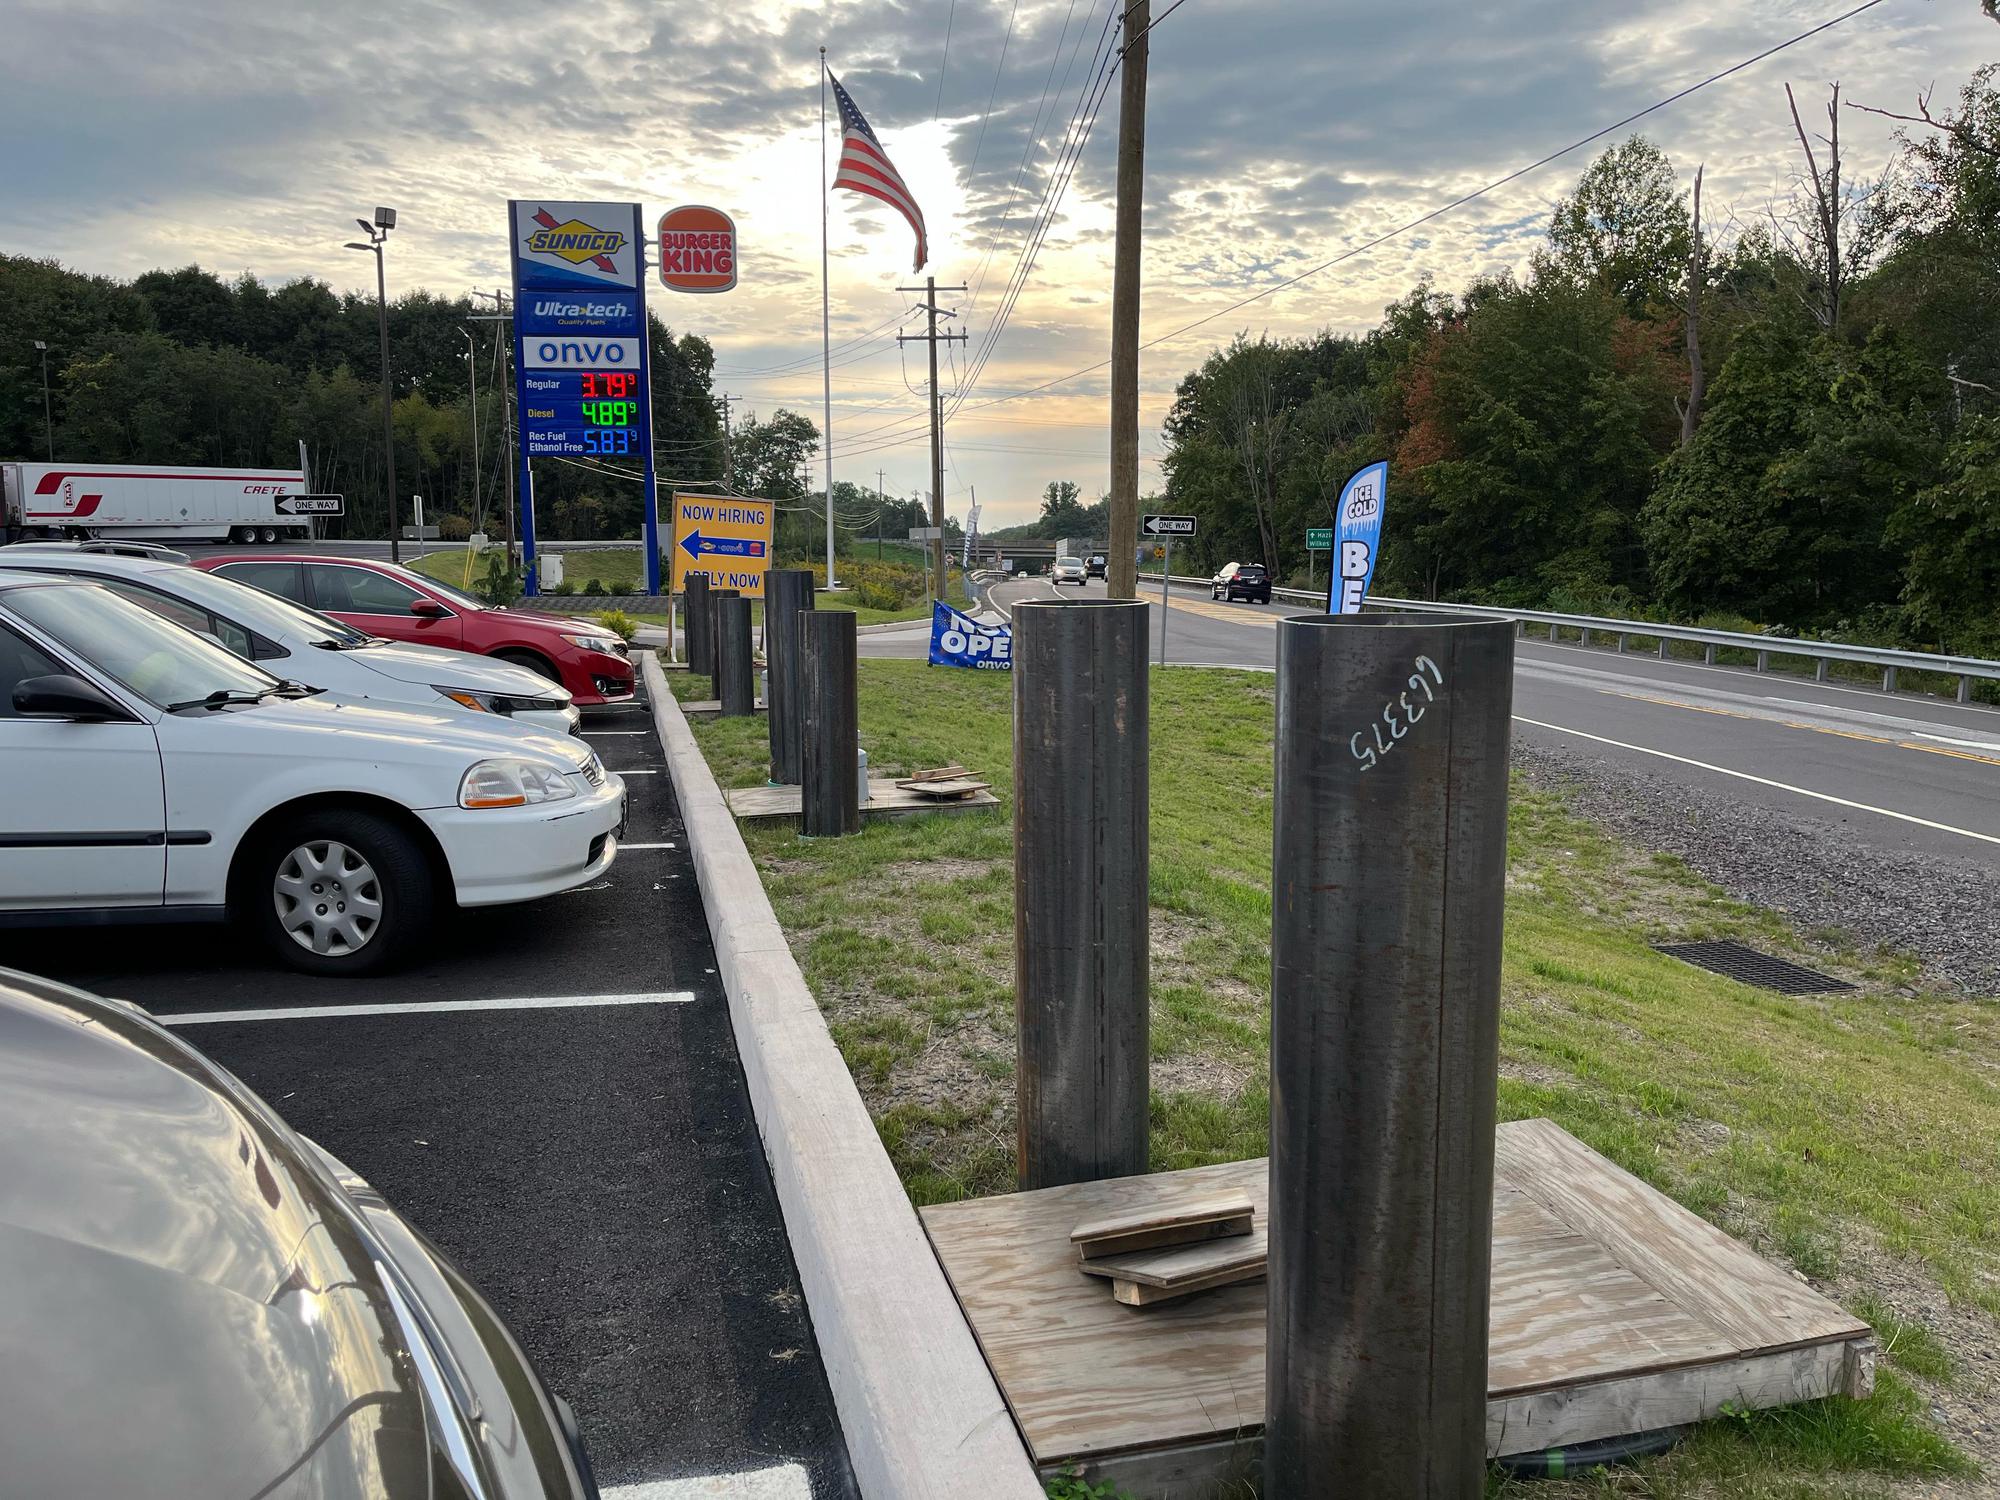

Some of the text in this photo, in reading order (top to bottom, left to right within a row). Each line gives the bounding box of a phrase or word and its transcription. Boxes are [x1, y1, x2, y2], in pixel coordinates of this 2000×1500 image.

[534, 233, 618, 251] SUNOCO
[661, 233, 732, 250] BURGER
[662, 250, 733, 273] KING
[539, 343, 624, 363] onvo
[526, 380, 560, 390] Regular
[528, 409, 554, 418] Diesel
[529, 432, 566, 441] Rec Fuel
[529, 443, 583, 452] Ethanol Free
[243, 486, 287, 495] CRETE
[1354, 484, 1372, 503] ICE
[295, 501, 336, 510] ONE WAY
[1347, 499, 1378, 519] COLD
[682, 505, 765, 525] NOW HIRING
[1158, 521, 1190, 530] ONE WAY
[729, 573, 760, 588] NOW
[940, 630, 1012, 659] OPE
[976, 660, 1011, 670] onvo
